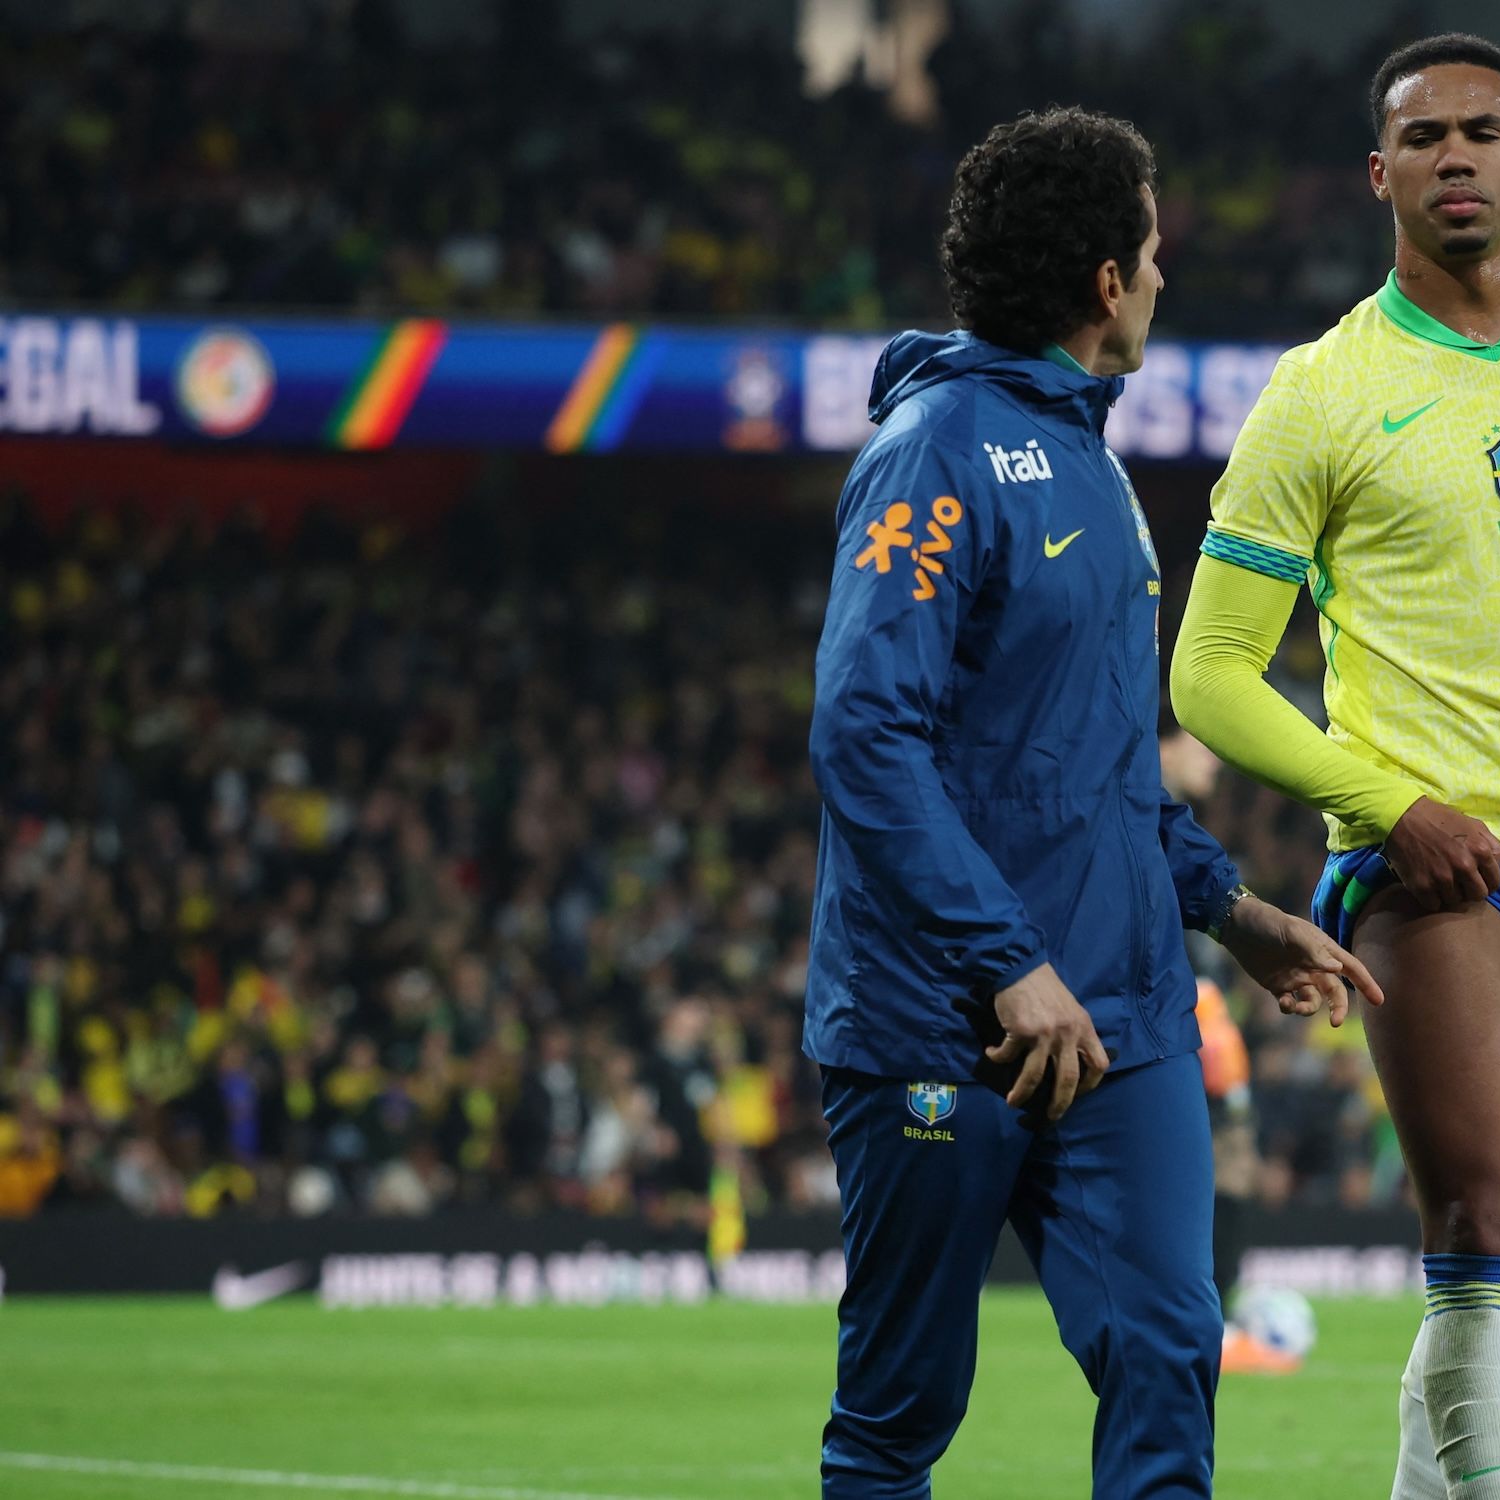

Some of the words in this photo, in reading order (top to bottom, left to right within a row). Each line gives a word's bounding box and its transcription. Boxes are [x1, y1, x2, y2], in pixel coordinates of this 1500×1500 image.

[0, 317, 161, 434] GAL
[983, 438, 1053, 483] itaú
[910, 495, 963, 601] vivo
[923, 1084, 943, 1094] CBF
[903, 1125, 956, 1141] BRASIL
